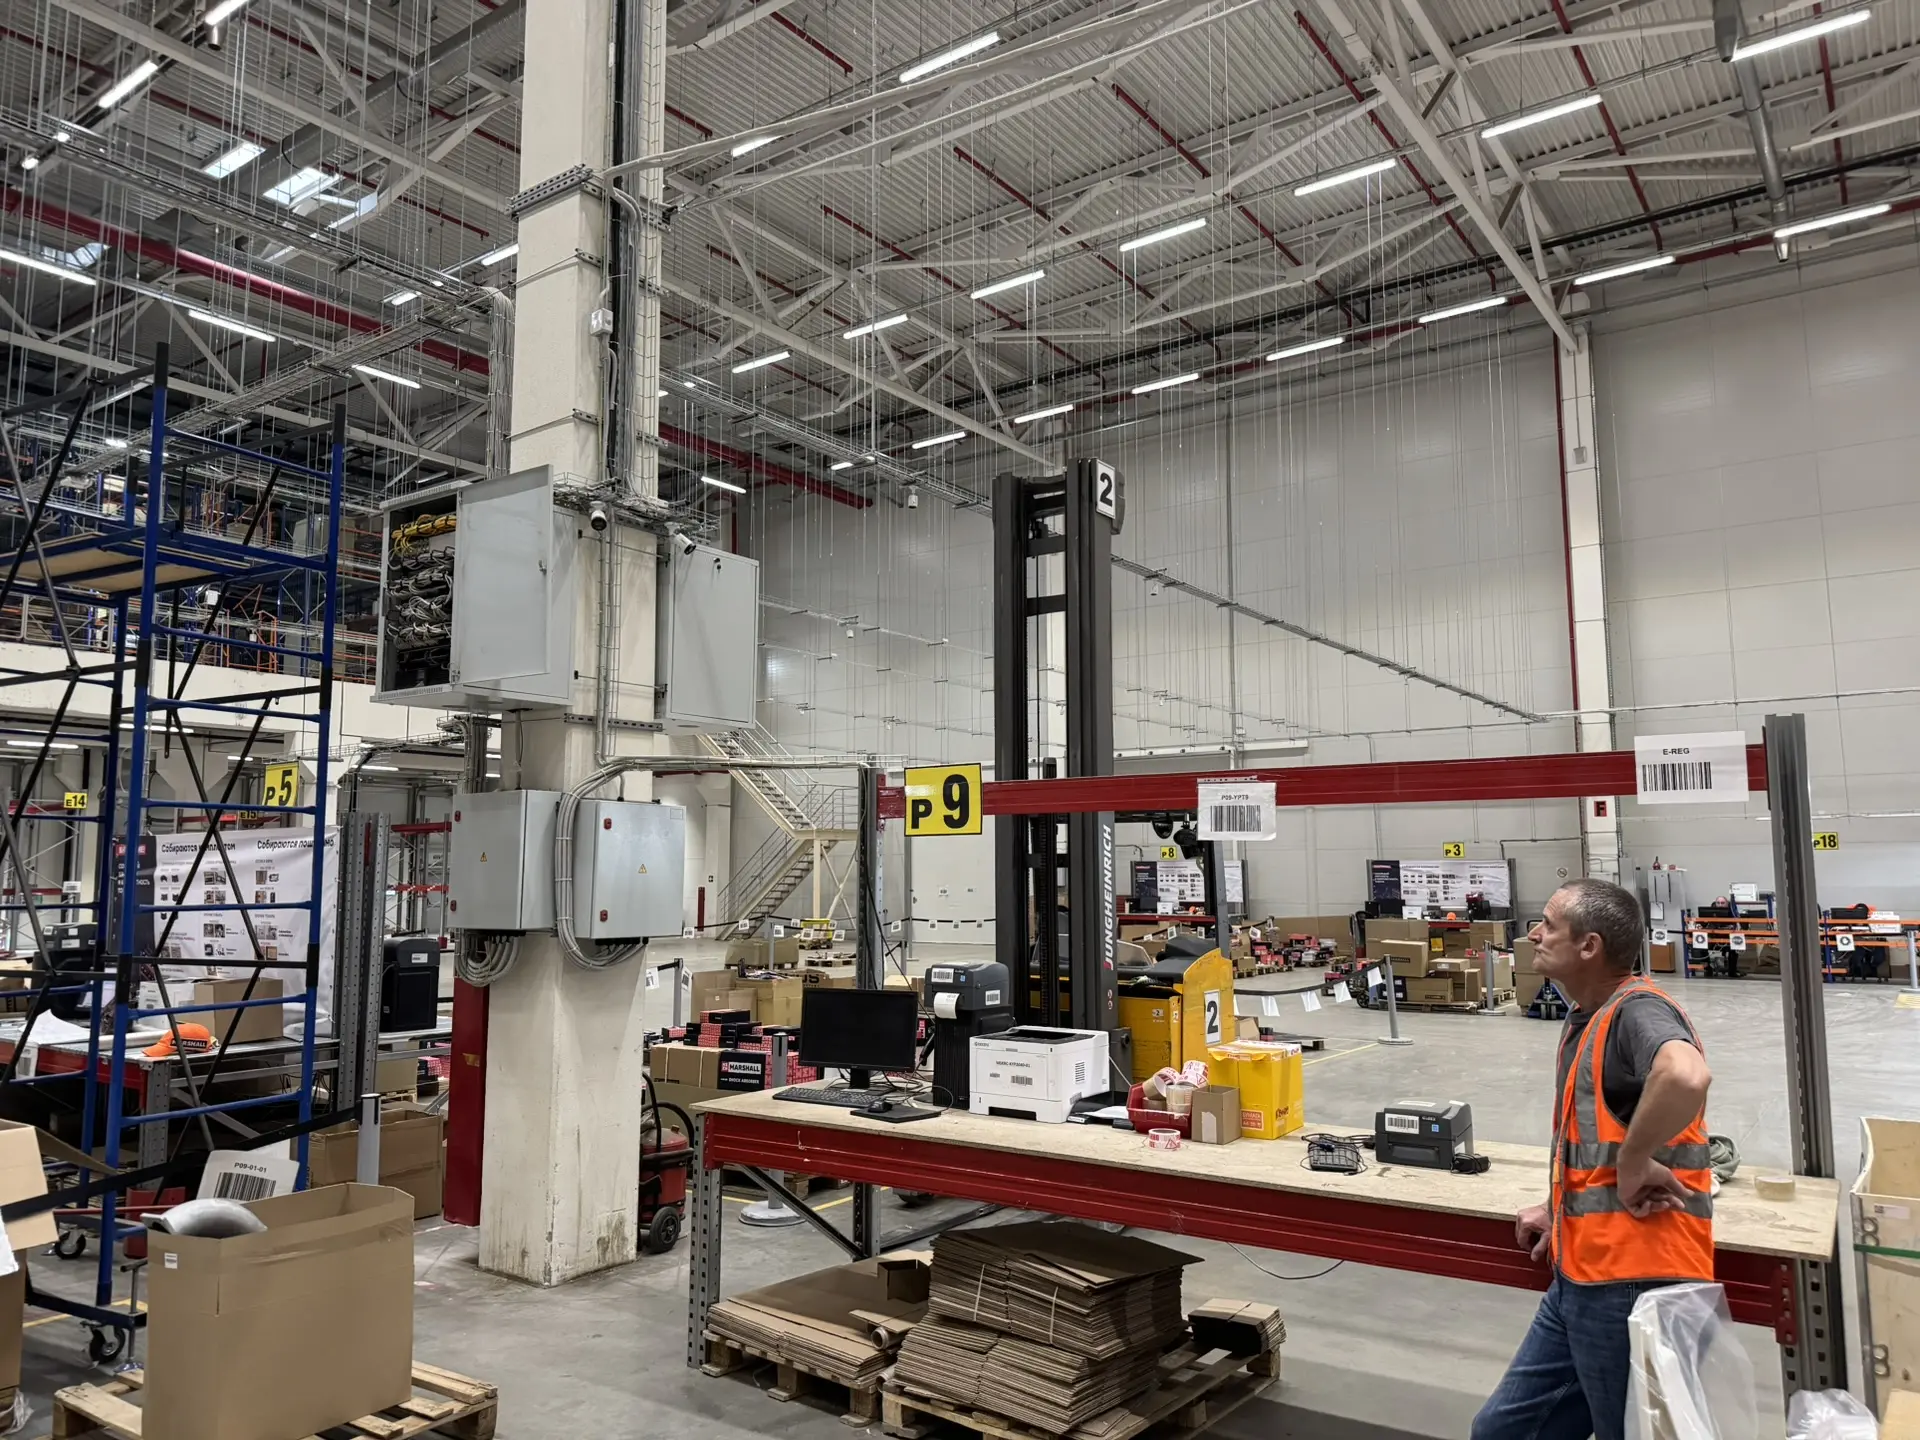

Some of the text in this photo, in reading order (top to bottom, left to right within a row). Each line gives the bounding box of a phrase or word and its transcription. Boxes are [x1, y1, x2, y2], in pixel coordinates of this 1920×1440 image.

[1100, 472, 1113, 507] 2
[1596, 801, 1606, 816] F
[1813, 834, 1837, 848] P18
[161, 843, 198, 855] Собираются
[1103, 824, 1114, 971] JUNGHEINRICH
[1206, 1000, 1218, 1034] 2
[729, 1063, 760, 1072] MARSHALL
[234, 1162, 267, 1173] P09-01-01
